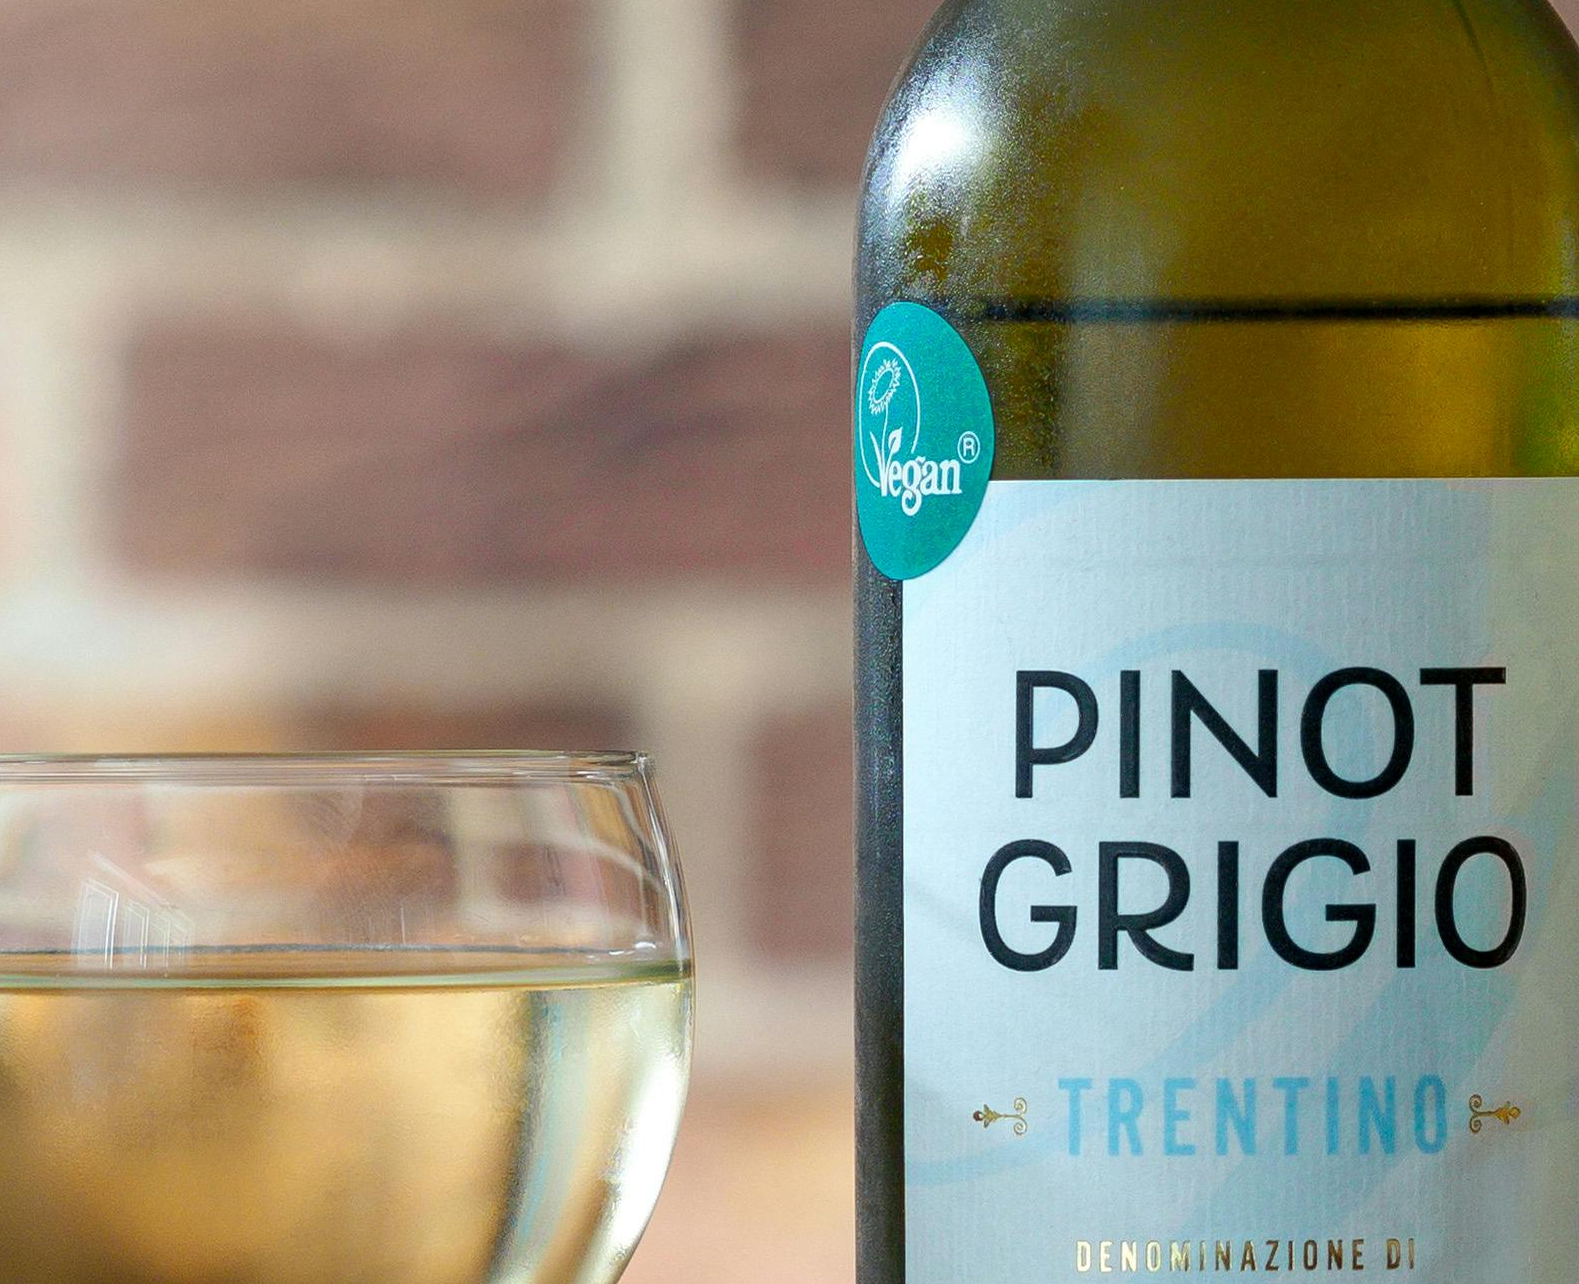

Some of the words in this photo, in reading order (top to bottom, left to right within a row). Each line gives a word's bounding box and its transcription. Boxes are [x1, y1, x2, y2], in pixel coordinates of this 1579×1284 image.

[1013, 666, 1507, 800] PINOT
[978, 835, 1528, 973] GRIGIO
[1057, 1073, 1450, 1158] TRENTINO
[1075, 1238, 1365, 1274] DENOMINAZIONE
[1385, 1237, 1416, 1271] DI
